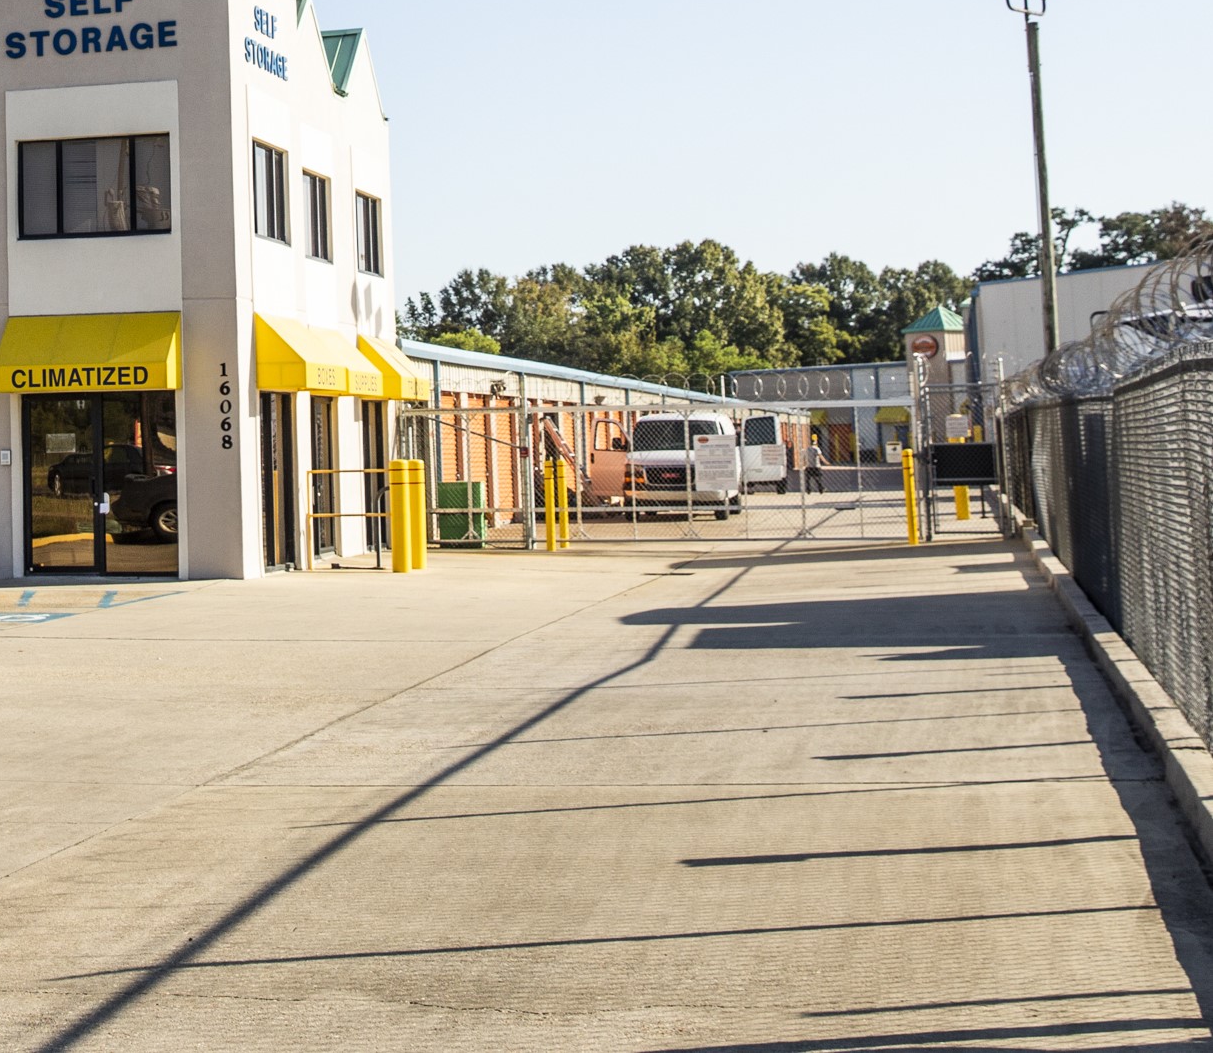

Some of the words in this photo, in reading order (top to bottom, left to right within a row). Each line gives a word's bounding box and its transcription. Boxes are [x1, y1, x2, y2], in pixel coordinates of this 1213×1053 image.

[5, 20, 178, 59] STORAGE
[253, 5, 277, 39] SELF
[244, 36, 288, 81] STORAGE
[11, 366, 149, 389] CLIMATIZED
[219, 362, 233, 449] 16068
